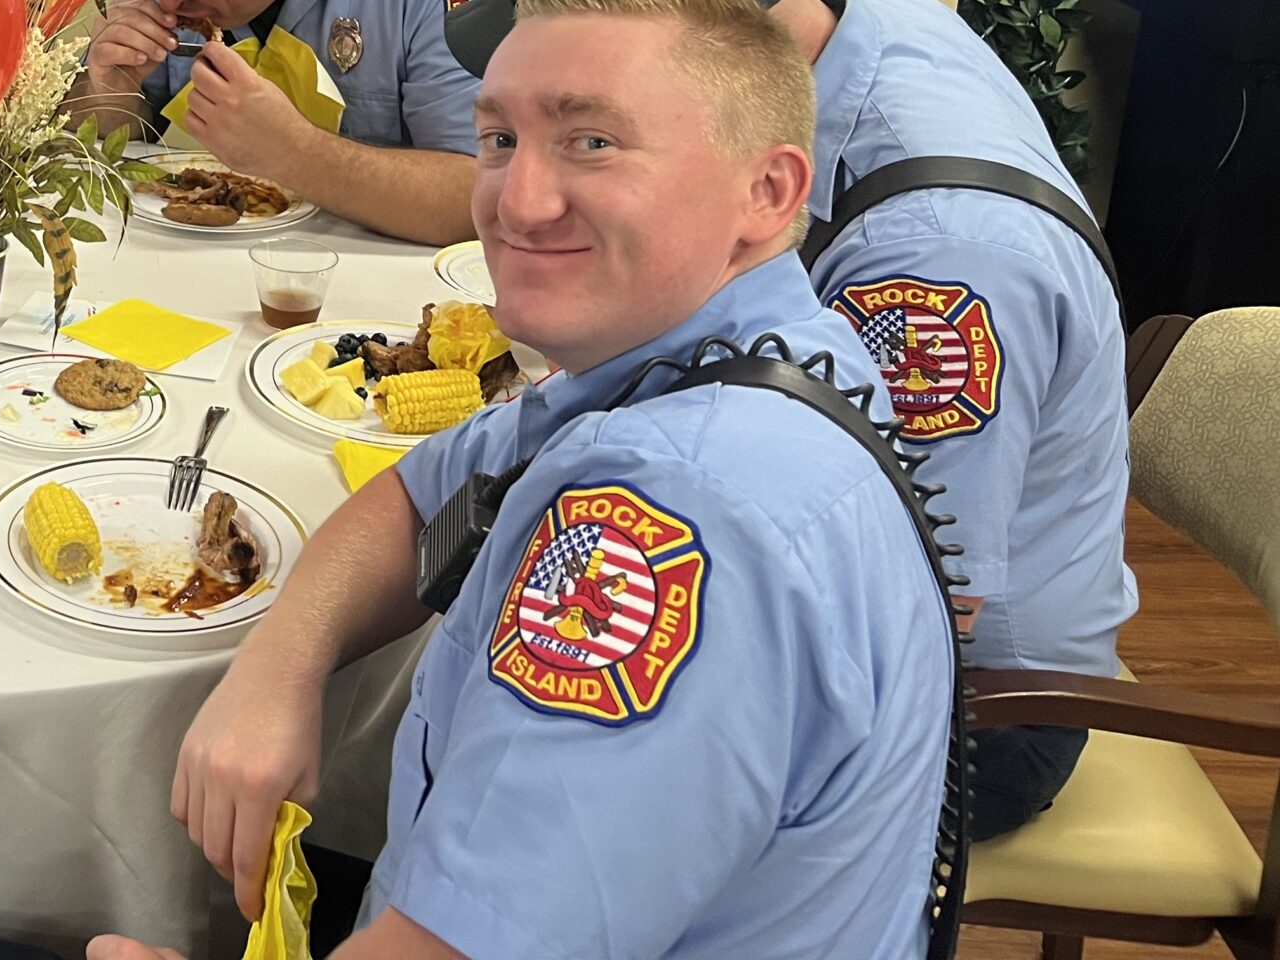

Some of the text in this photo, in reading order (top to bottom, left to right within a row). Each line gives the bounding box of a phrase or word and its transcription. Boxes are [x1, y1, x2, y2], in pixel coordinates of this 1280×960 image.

[862, 288, 948, 311] ROCK
[969, 326, 989, 393] DEPT
[569, 498, 665, 548] ROCK
[503, 538, 543, 625] FIRE
[644, 583, 688, 680] DEPT
[506, 649, 602, 701] ISLAND
